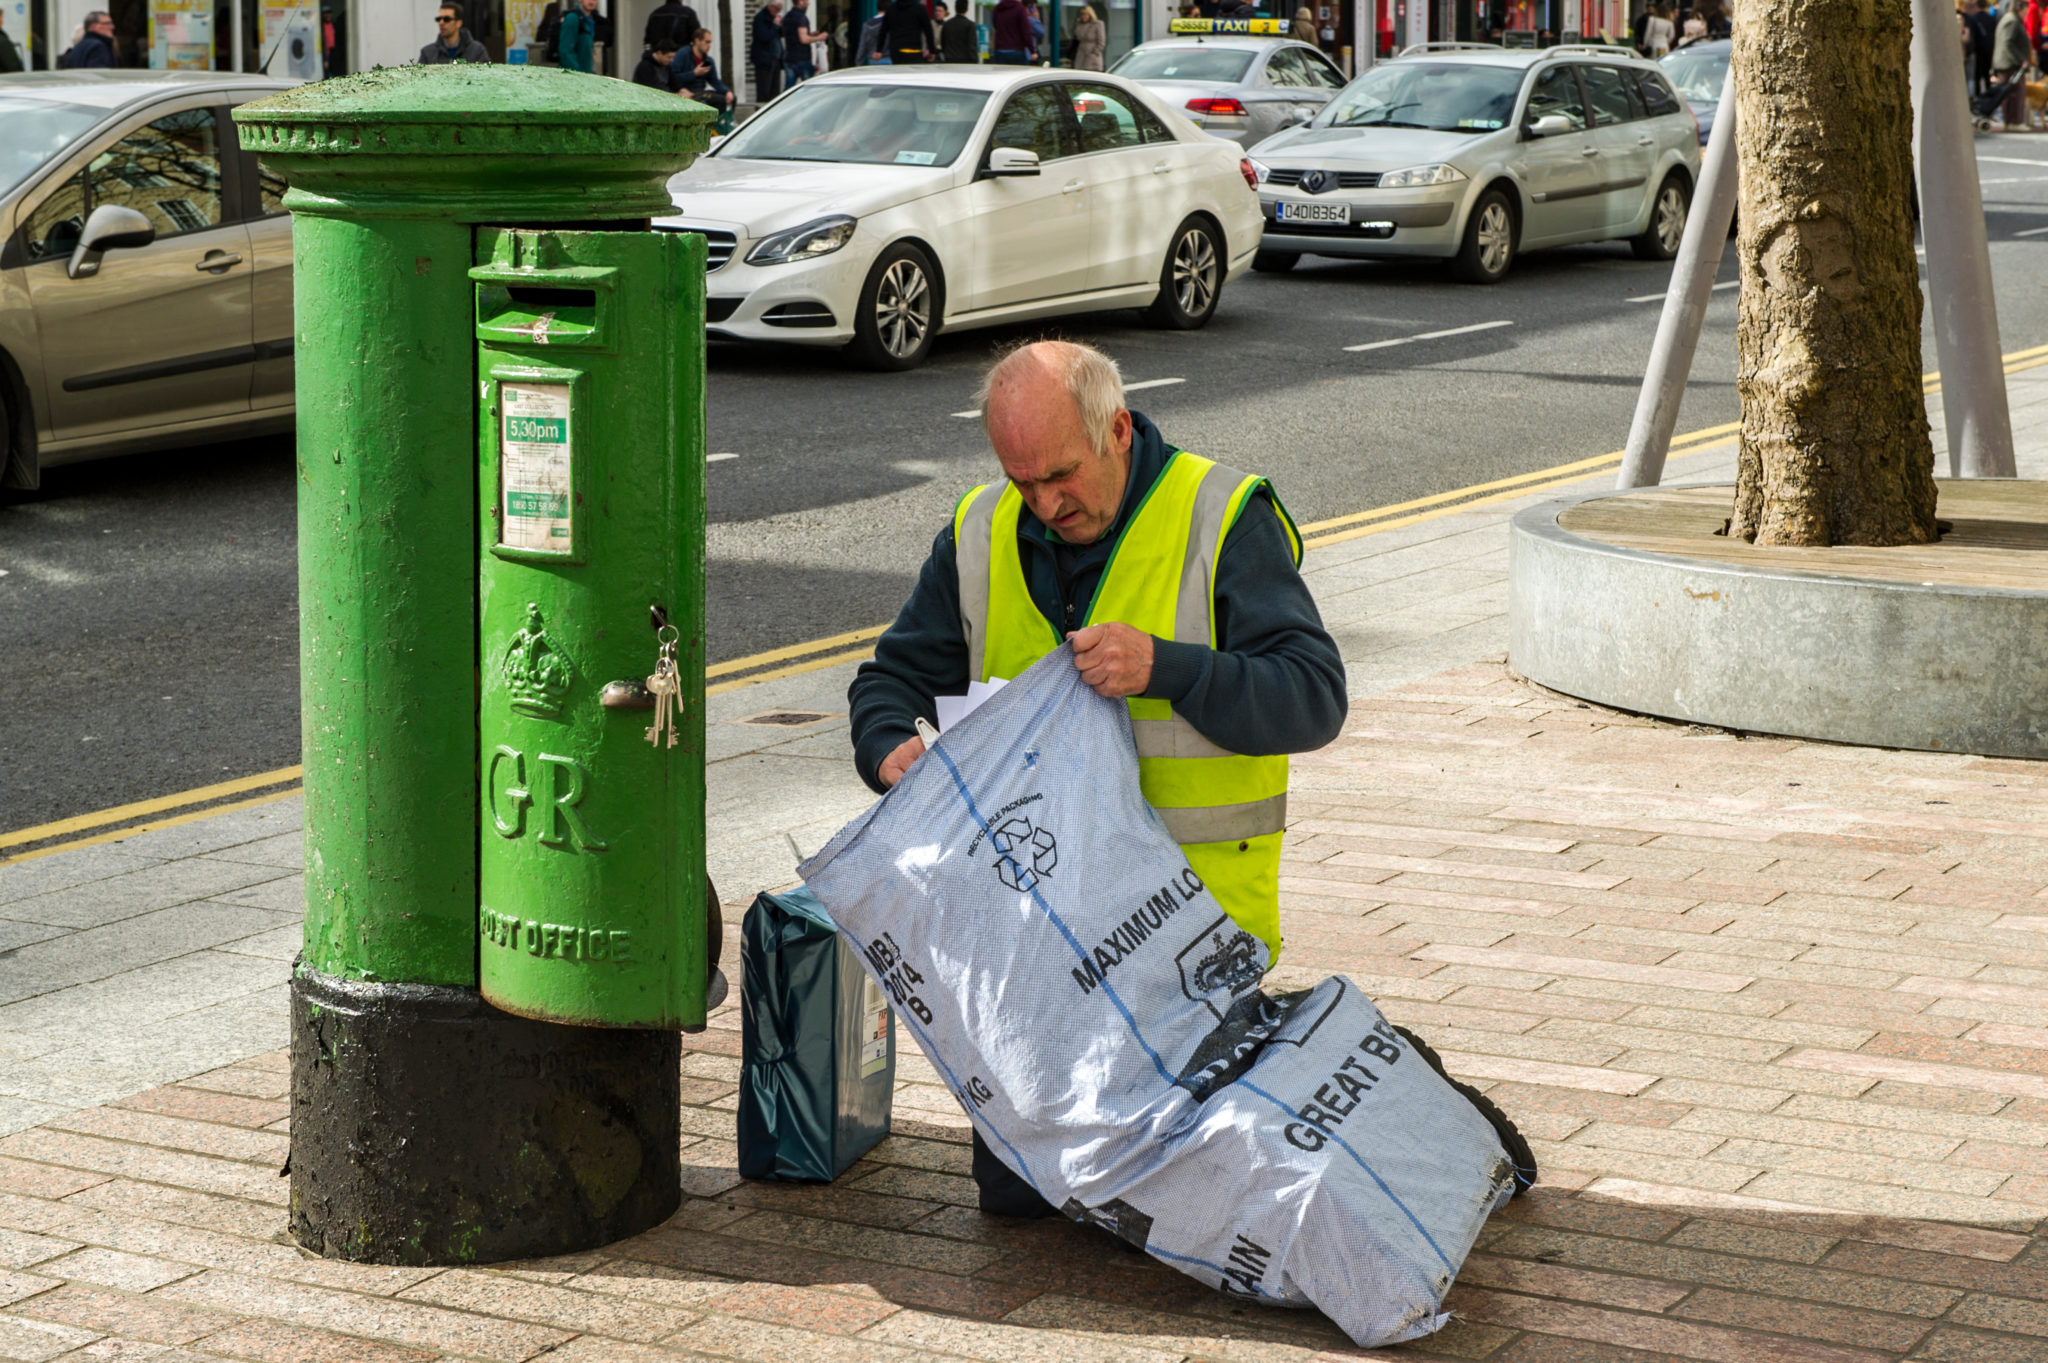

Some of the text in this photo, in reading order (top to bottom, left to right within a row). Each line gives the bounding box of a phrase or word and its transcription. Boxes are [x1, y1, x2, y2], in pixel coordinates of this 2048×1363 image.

[1214, 20, 1249, 32] TAXI
[488, 744, 610, 851] GR
[967, 792, 1043, 857] RECYCLABLE PACKAGING
[480, 904, 632, 963] POST OFFICE
[1071, 887, 1180, 995] MAXIMUM
[884, 961, 925, 1006] 2014
[907, 996, 933, 1026] B
[1284, 1055, 1380, 1152] GREAT
